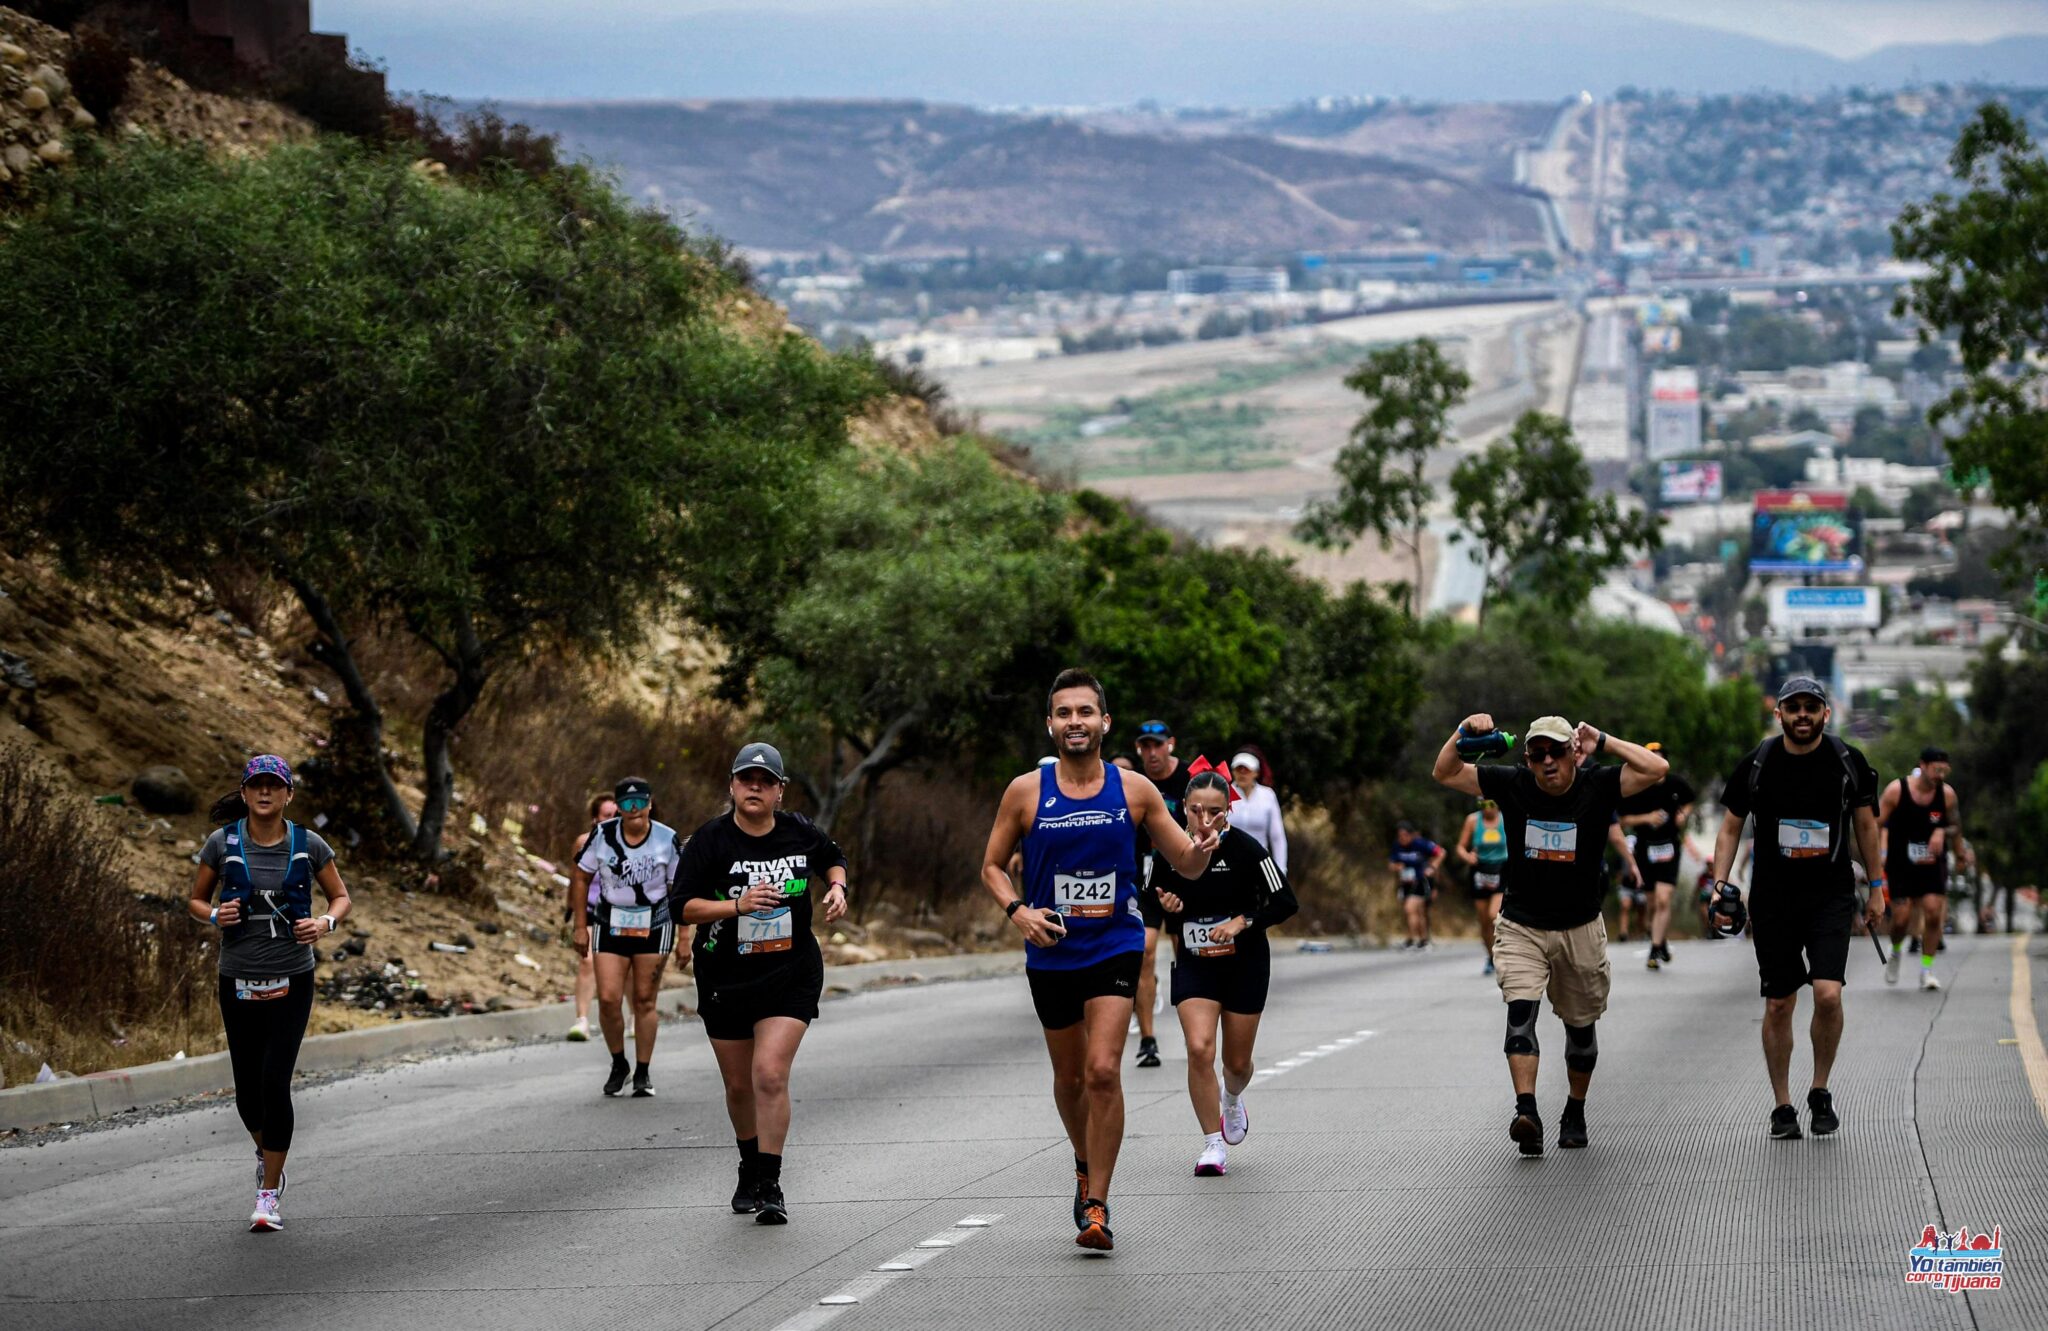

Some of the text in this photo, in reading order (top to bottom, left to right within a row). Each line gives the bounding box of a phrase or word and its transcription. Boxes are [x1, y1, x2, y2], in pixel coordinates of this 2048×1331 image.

[1038, 817, 1113, 830] Frontrunners
[1086, 813, 1106, 821] Beach
[1541, 832, 1561, 848] 10
[1799, 831, 1809, 845] 9
[748, 867, 795, 886] ESTA
[728, 878, 808, 899] CGON
[1061, 882, 1111, 900] 1242
[619, 912, 643, 925] 321
[749, 920, 781, 939] 771
